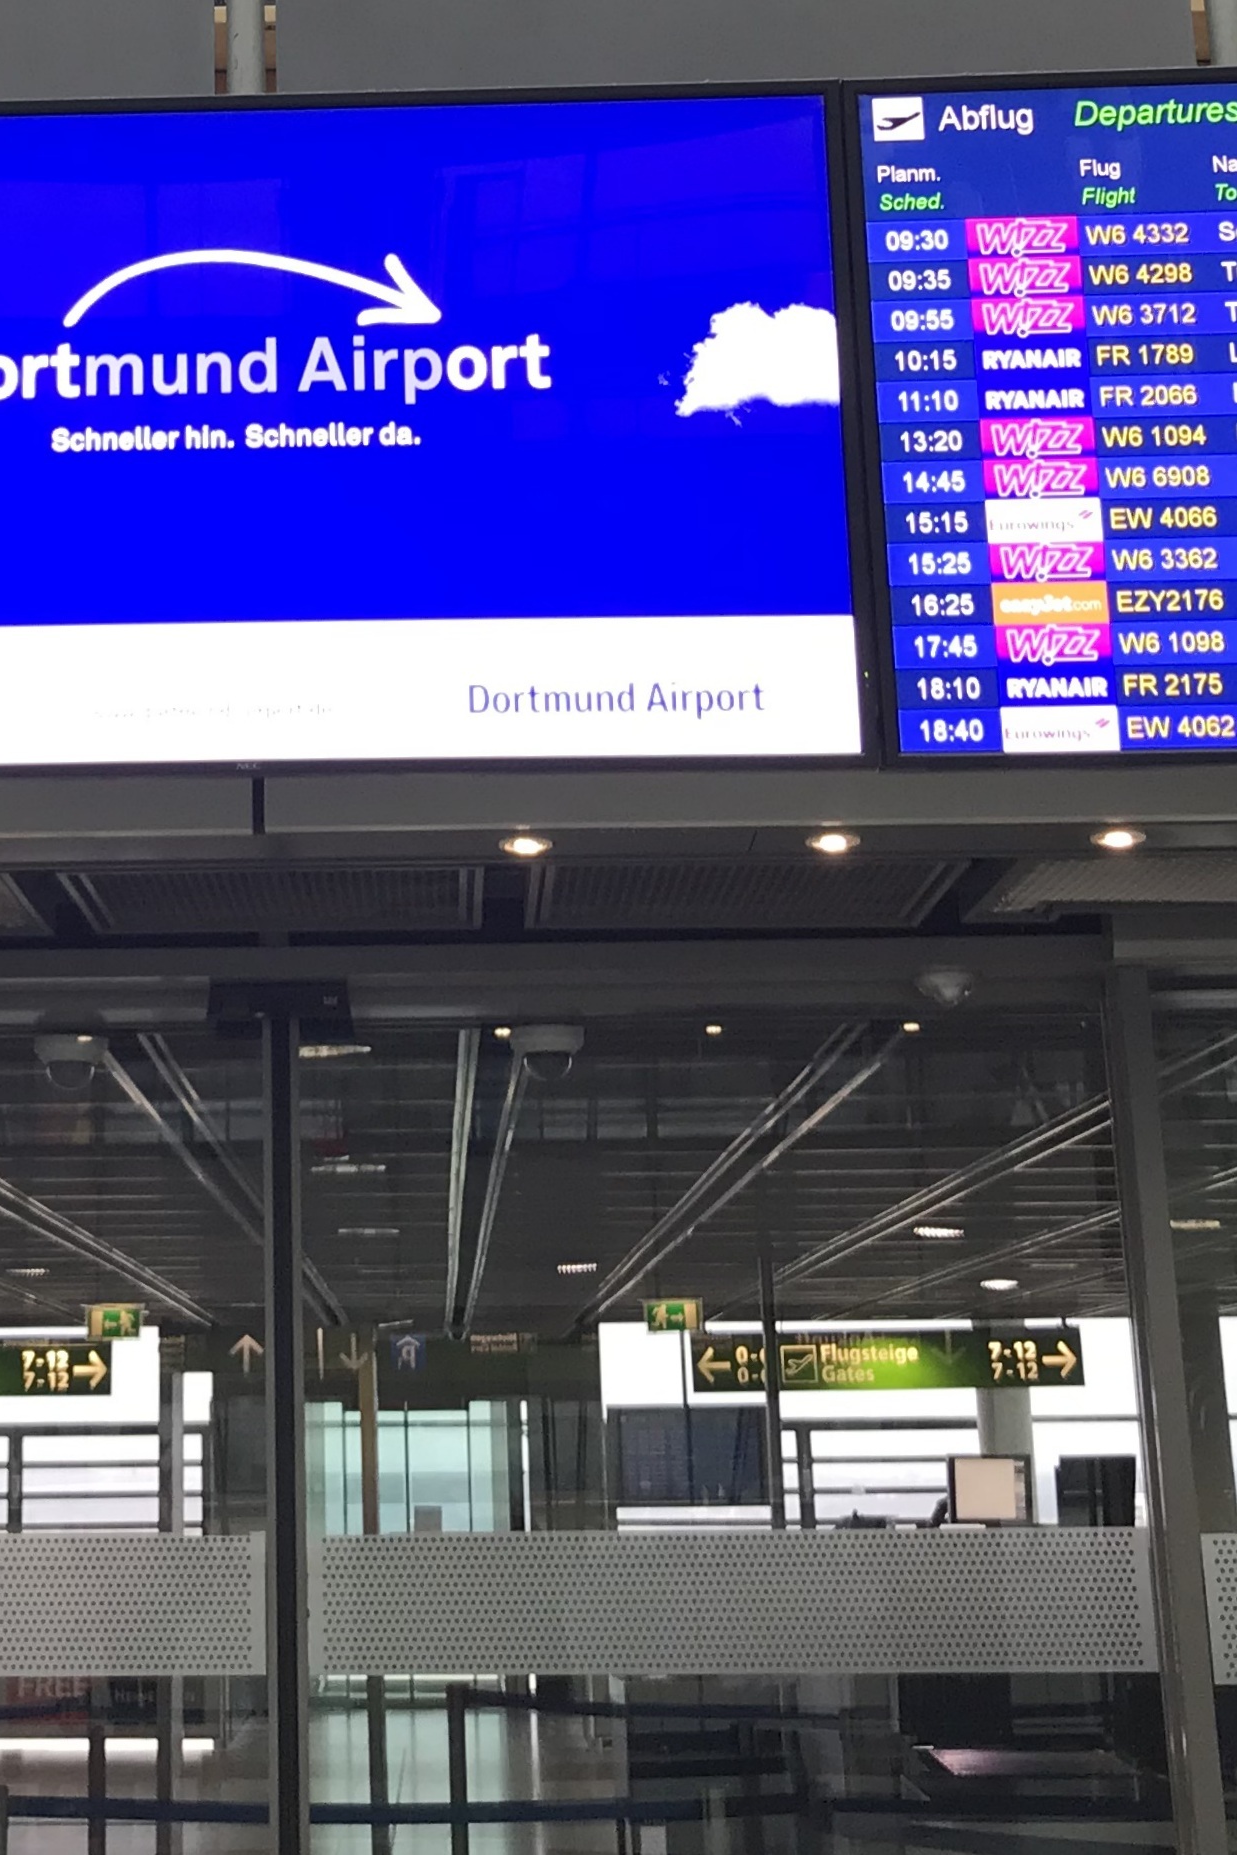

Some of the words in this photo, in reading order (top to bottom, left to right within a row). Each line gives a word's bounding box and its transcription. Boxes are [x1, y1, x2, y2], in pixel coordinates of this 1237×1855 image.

[939, 104, 1033, 135] Abflug
[1075, 99, 1237, 131] Departures
[877, 165, 940, 183] Planm.
[1080, 159, 1121, 180] Flug
[880, 192, 944, 211] Sched.
[1082, 187, 1135, 208] Flight
[886, 229, 948, 251] 09:30
[1085, 225, 1125, 245] W6
[1133, 223, 1189, 243] 4332
[888, 269, 951, 291] 09:35
[1089, 265, 1129, 285] W6
[1136, 263, 1192, 284] 4298
[891, 309, 954, 331] 09:55
[1092, 304, 1132, 325] W6
[1140, 303, 1196, 324] 3712
[895, 349, 957, 371] 10:15
[982, 348, 1081, 370] RYANAIR
[1097, 345, 1130, 366] FR
[1139, 344, 1193, 365] 1789
[298, 334, 551, 404] Airport
[899, 390, 958, 412] 11:10
[985, 389, 1084, 410] RYANAIR
[1100, 386, 1133, 407] FR
[1140, 384, 1197, 406] 2066
[51, 426, 180, 452] Schneller
[185, 425, 234, 449] hin.
[245, 422, 374, 448] Schneller
[379, 421, 421, 446] da.
[901, 430, 962, 452] 13:20
[1102, 426, 1143, 447] W6
[1152, 425, 1206, 446] 1094
[903, 470, 965, 493] 14:45
[1105, 467, 1146, 488] W6
[1153, 465, 1210, 487] 6908
[906, 511, 968, 533] 15:15
[1110, 508, 1152, 529] EW
[1160, 506, 1217, 528] 4066
[909, 552, 971, 575] 15:25
[1112, 549, 1153, 570] W6
[1161, 548, 1218, 569] 3362
[912, 593, 974, 616] 16:25
[1117, 589, 1224, 612] EZY2176
[915, 635, 977, 658] 17:45
[1118, 632, 1160, 654] W6
[1169, 631, 1224, 653] 1098
[917, 677, 980, 700] 18:10
[1007, 677, 1108, 698] RYANAIR
[1123, 674, 1158, 696] FR
[1165, 673, 1223, 696] 2175
[469, 683, 634, 713] Dortmund
[647, 683, 764, 719] Airport
[920, 719, 983, 742] 18:40
[1127, 716, 1169, 738] EW
[1178, 715, 1235, 737] 4062
[820, 1344, 918, 1365] Flugsteige
[822, 1365, 874, 1383] Gates
